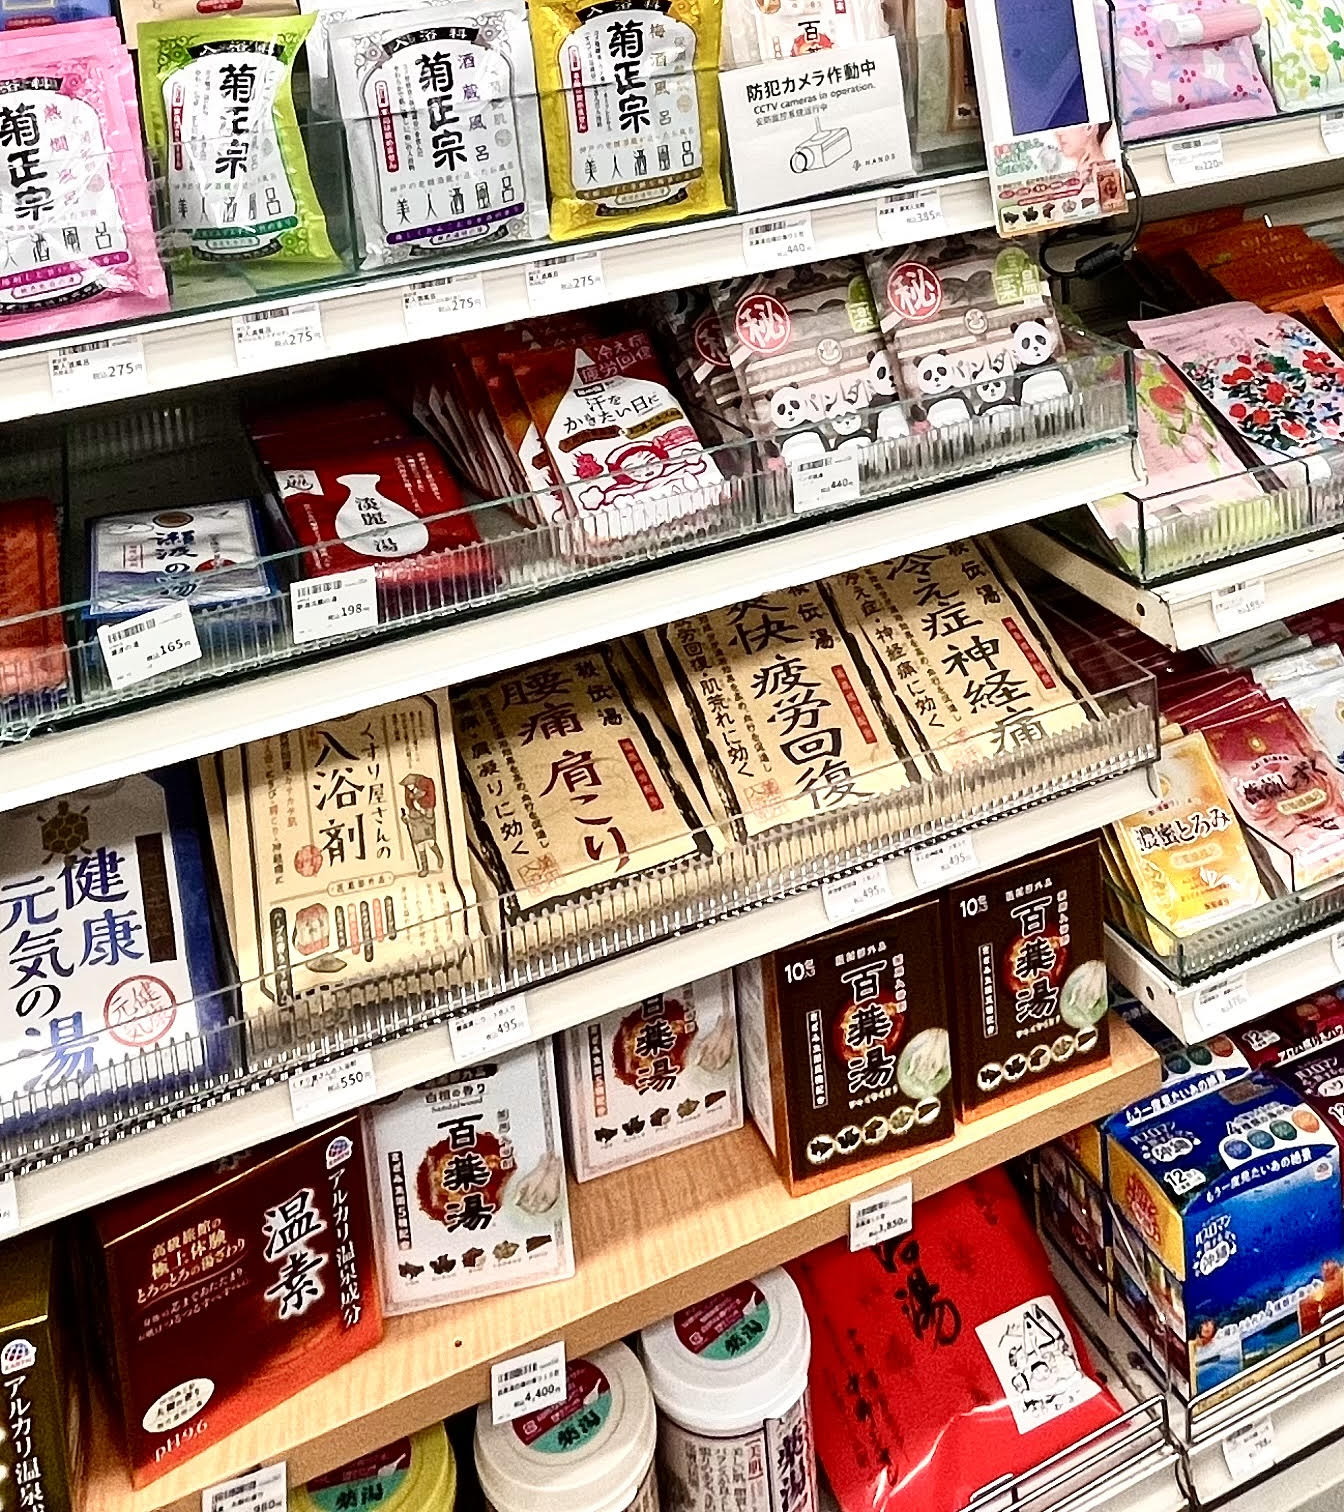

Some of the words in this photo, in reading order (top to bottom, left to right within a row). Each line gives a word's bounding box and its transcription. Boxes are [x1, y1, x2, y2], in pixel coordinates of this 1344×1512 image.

[457, 52, 491, 162] 酒蔵風呂
[607, 20, 651, 134] 菊正宗
[648, 24, 673, 127] 梅酒風呂
[746, 59, 876, 100] 防犯カメラ作動中
[753, 103, 777, 115] CCTV
[779, 96, 817, 111] cameras
[819, 94, 828, 103] in
[830, 82, 876, 100] operation.
[215, 64, 257, 180] 菊正宗
[414, 50, 468, 172] 菊正宗
[865, 154, 897, 166] HANDS
[394, 176, 514, 226] 美人酒風呂
[893, 268, 936, 316] 秘
[563, 395, 660, 434] かきたい日に
[585, 393, 621, 411] 汗を
[155, 530, 205, 597] 瀬波の湯
[887, 548, 983, 642] 冷え症
[499, 668, 586, 746] 腰痛
[940, 635, 1046, 757] 神経痛
[751, 655, 870, 811] 疲労回復
[312, 730, 366, 867] 入浴剤
[359, 721, 394, 860] くすり屋さんの
[541, 749, 634, 872] 肩こり
[1134, 807, 1231, 853] 濃蜜とろみ
[56, 846, 144, 968] 健康
[136, 1238, 247, 1304] とろっとろの湯ざわり
[151, 1216, 222, 1259] 高級旅館の
[151, 1231, 228, 1281] 極上体験
[263, 1188, 327, 1321] 温素
[328, 1168, 362, 1328] アルカリ温泉成分
[724, 1323, 764, 1356] 薬湯
[155, 1419, 209, 1462] pH9.6
[557, 1412, 601, 1449] 薬湯
[336, 1479, 384, 1512] 薬湯
